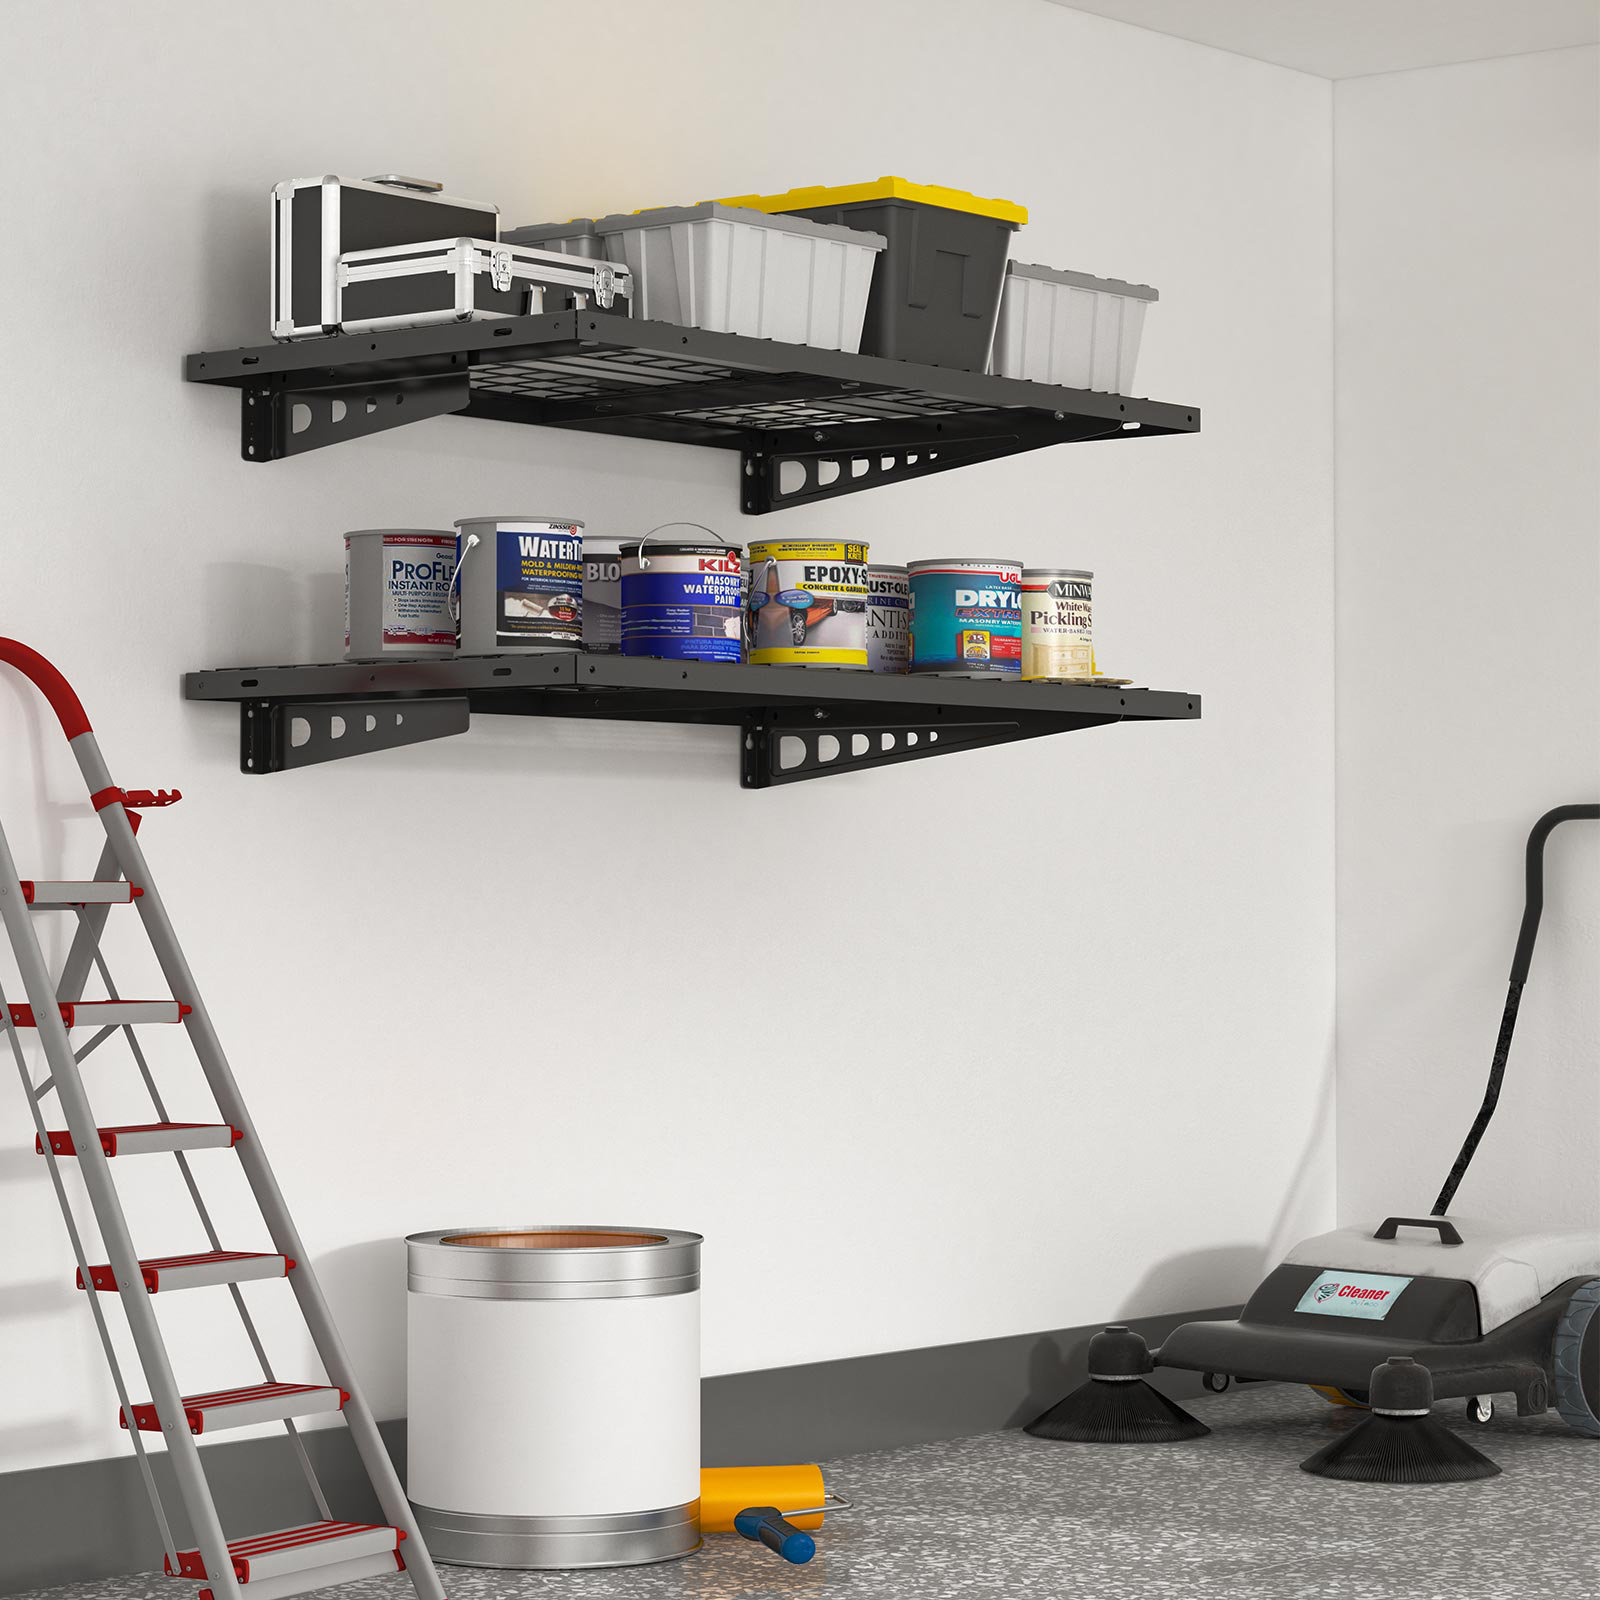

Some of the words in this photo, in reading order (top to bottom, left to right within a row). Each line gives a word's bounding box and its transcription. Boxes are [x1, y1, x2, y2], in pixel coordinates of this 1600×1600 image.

[699, 559, 740, 574] KILZ
[389, 581, 433, 590] INSTANT
[803, 584, 838, 592] CONCRETE
[715, 595, 735, 605] PAINT
[1056, 602, 1082, 612] White
[1031, 610, 1087, 629] Pickling
[1338, 1285, 1390, 1300] Cleaner
